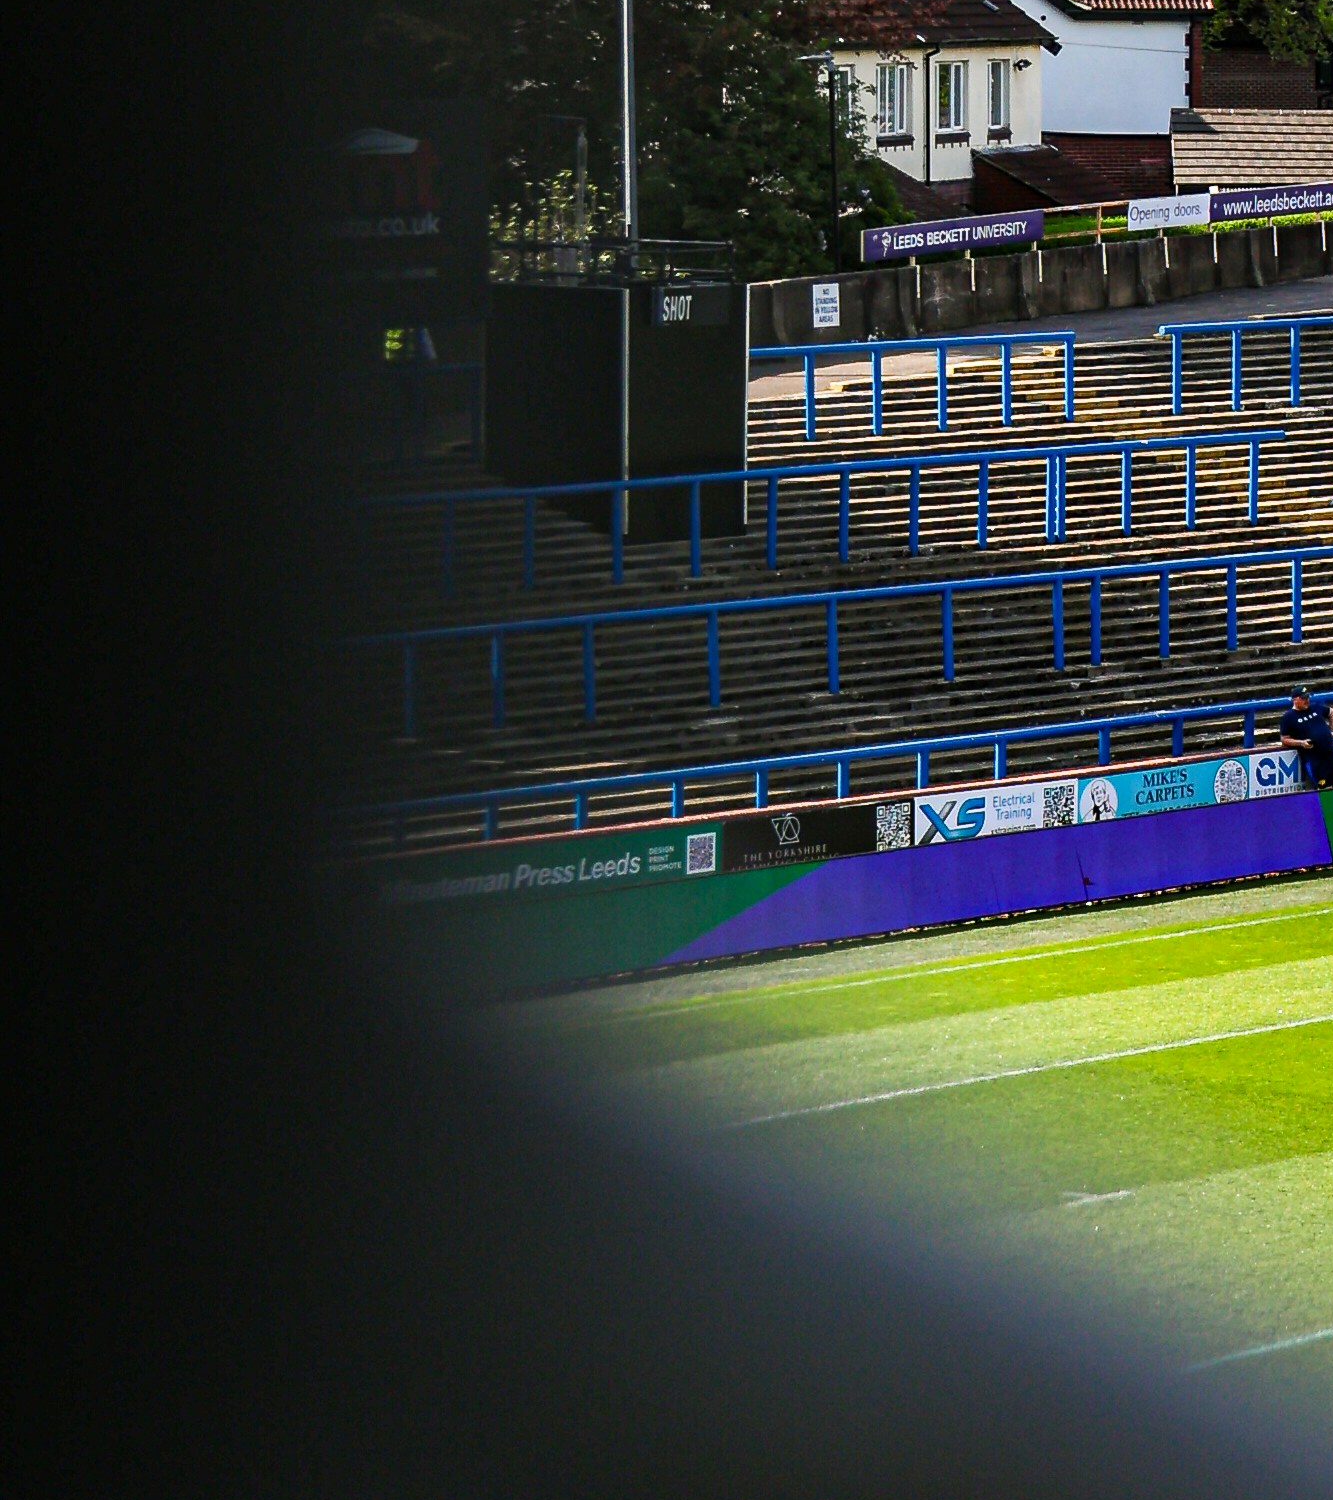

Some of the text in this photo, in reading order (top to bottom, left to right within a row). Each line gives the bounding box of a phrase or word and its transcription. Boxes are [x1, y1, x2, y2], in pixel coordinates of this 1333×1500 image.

[1129, 203, 1202, 224] Opening doors.
[893, 220, 1027, 250] LEEDS BECKETT UNIVERSITY
[1142, 768, 1187, 788] MIKE'S
[993, 791, 1035, 808] Electrical
[1135, 784, 1195, 806] CARPETS
[918, 796, 986, 845] XS
[996, 807, 1032, 821] Training
[649, 846, 674, 855] DESIGN
[649, 854, 669, 863] PRINT
[513, 862, 575, 890] Press
[578, 851, 641, 882] Leeds
[649, 862, 682, 872] PROMOTE
